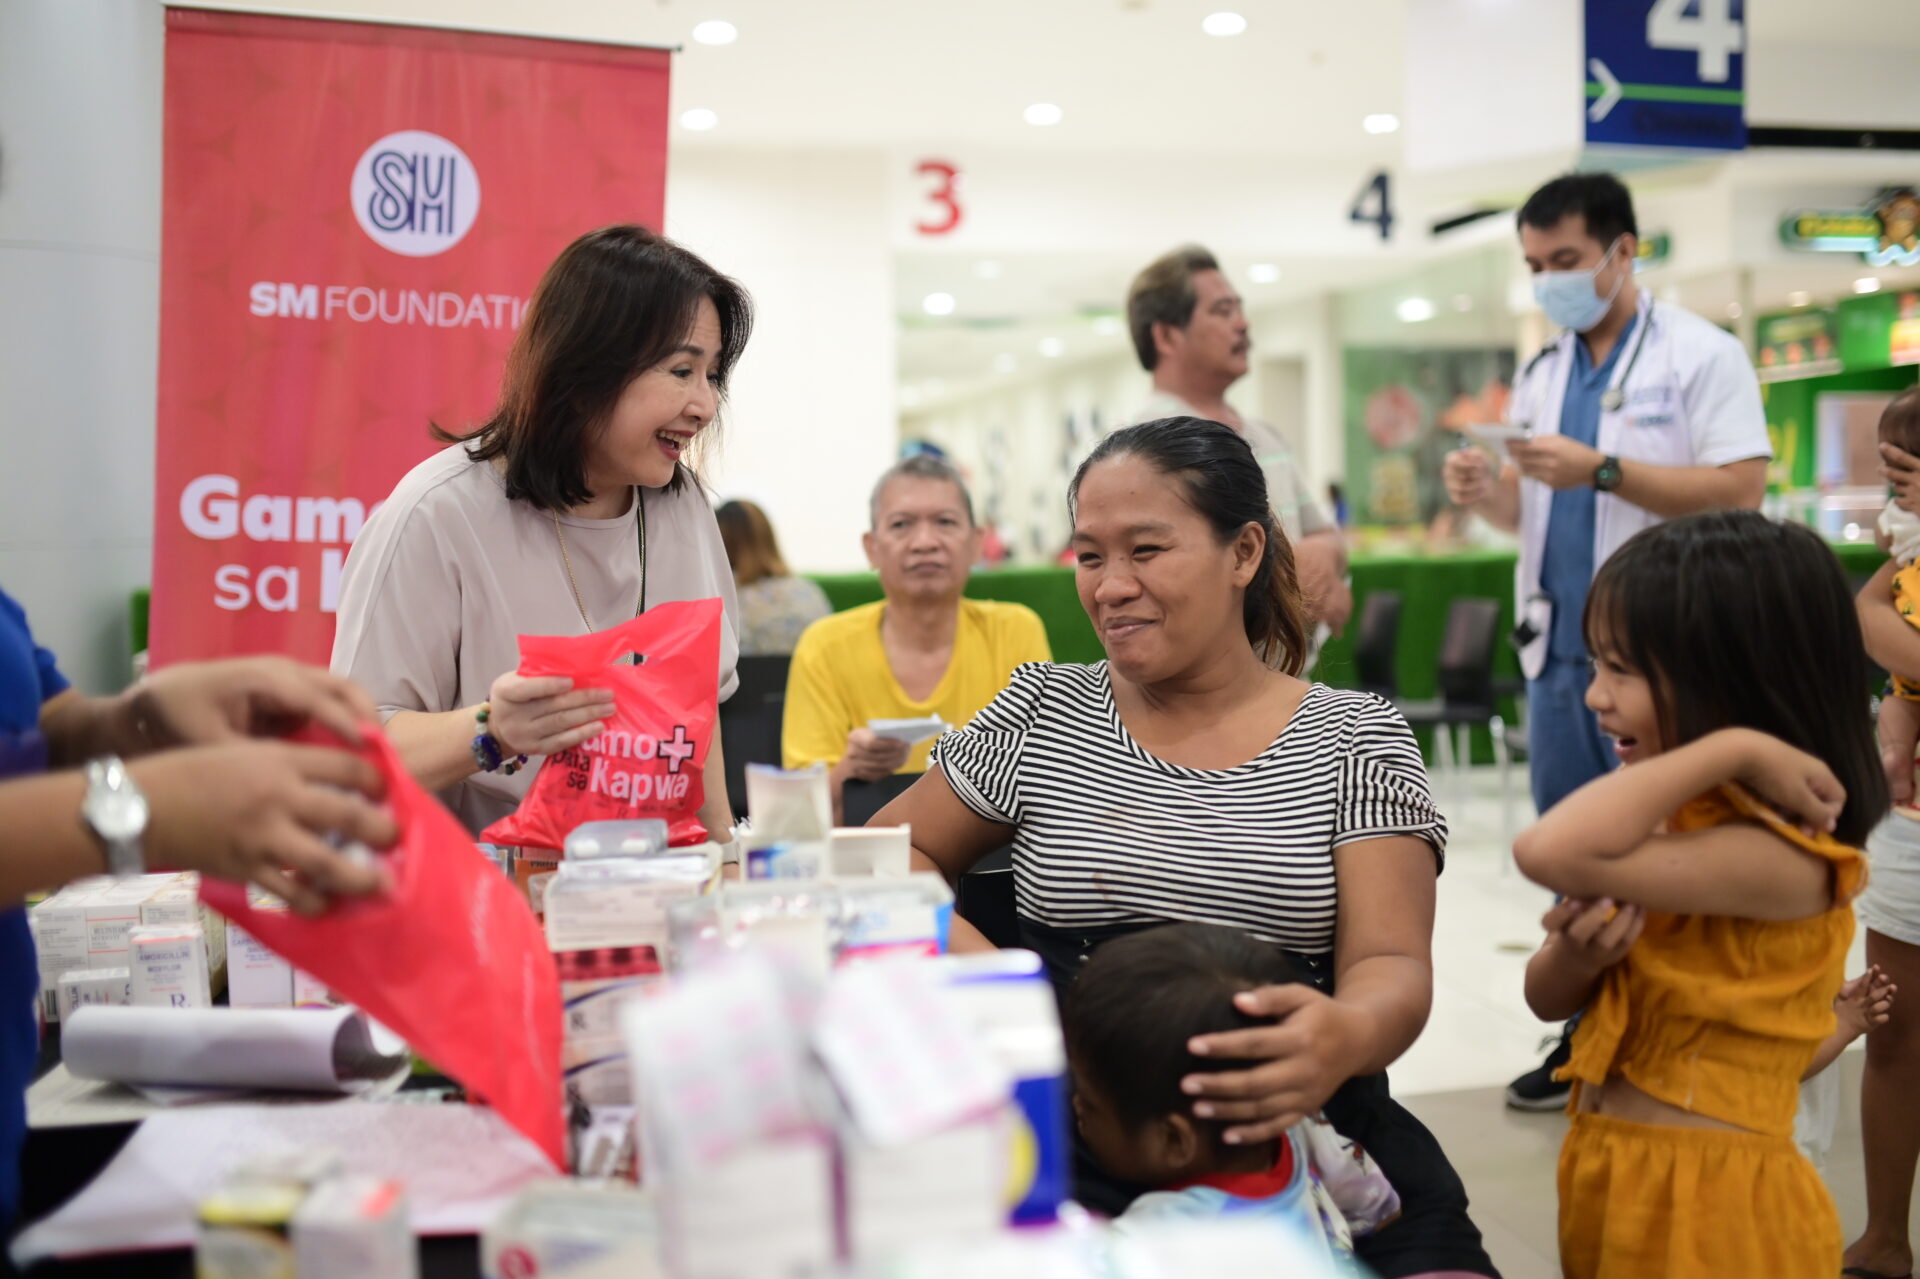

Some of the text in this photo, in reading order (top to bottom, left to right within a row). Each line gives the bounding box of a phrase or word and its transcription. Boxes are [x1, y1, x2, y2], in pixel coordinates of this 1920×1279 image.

[1645, 0, 1742, 83] 4
[369, 150, 455, 236] SM
[912, 159, 964, 236] 3
[1348, 170, 1395, 241] 4
[249, 282, 318, 319] SM
[214, 564, 299, 612] sa
[567, 757, 690, 808] sa Kapwa
